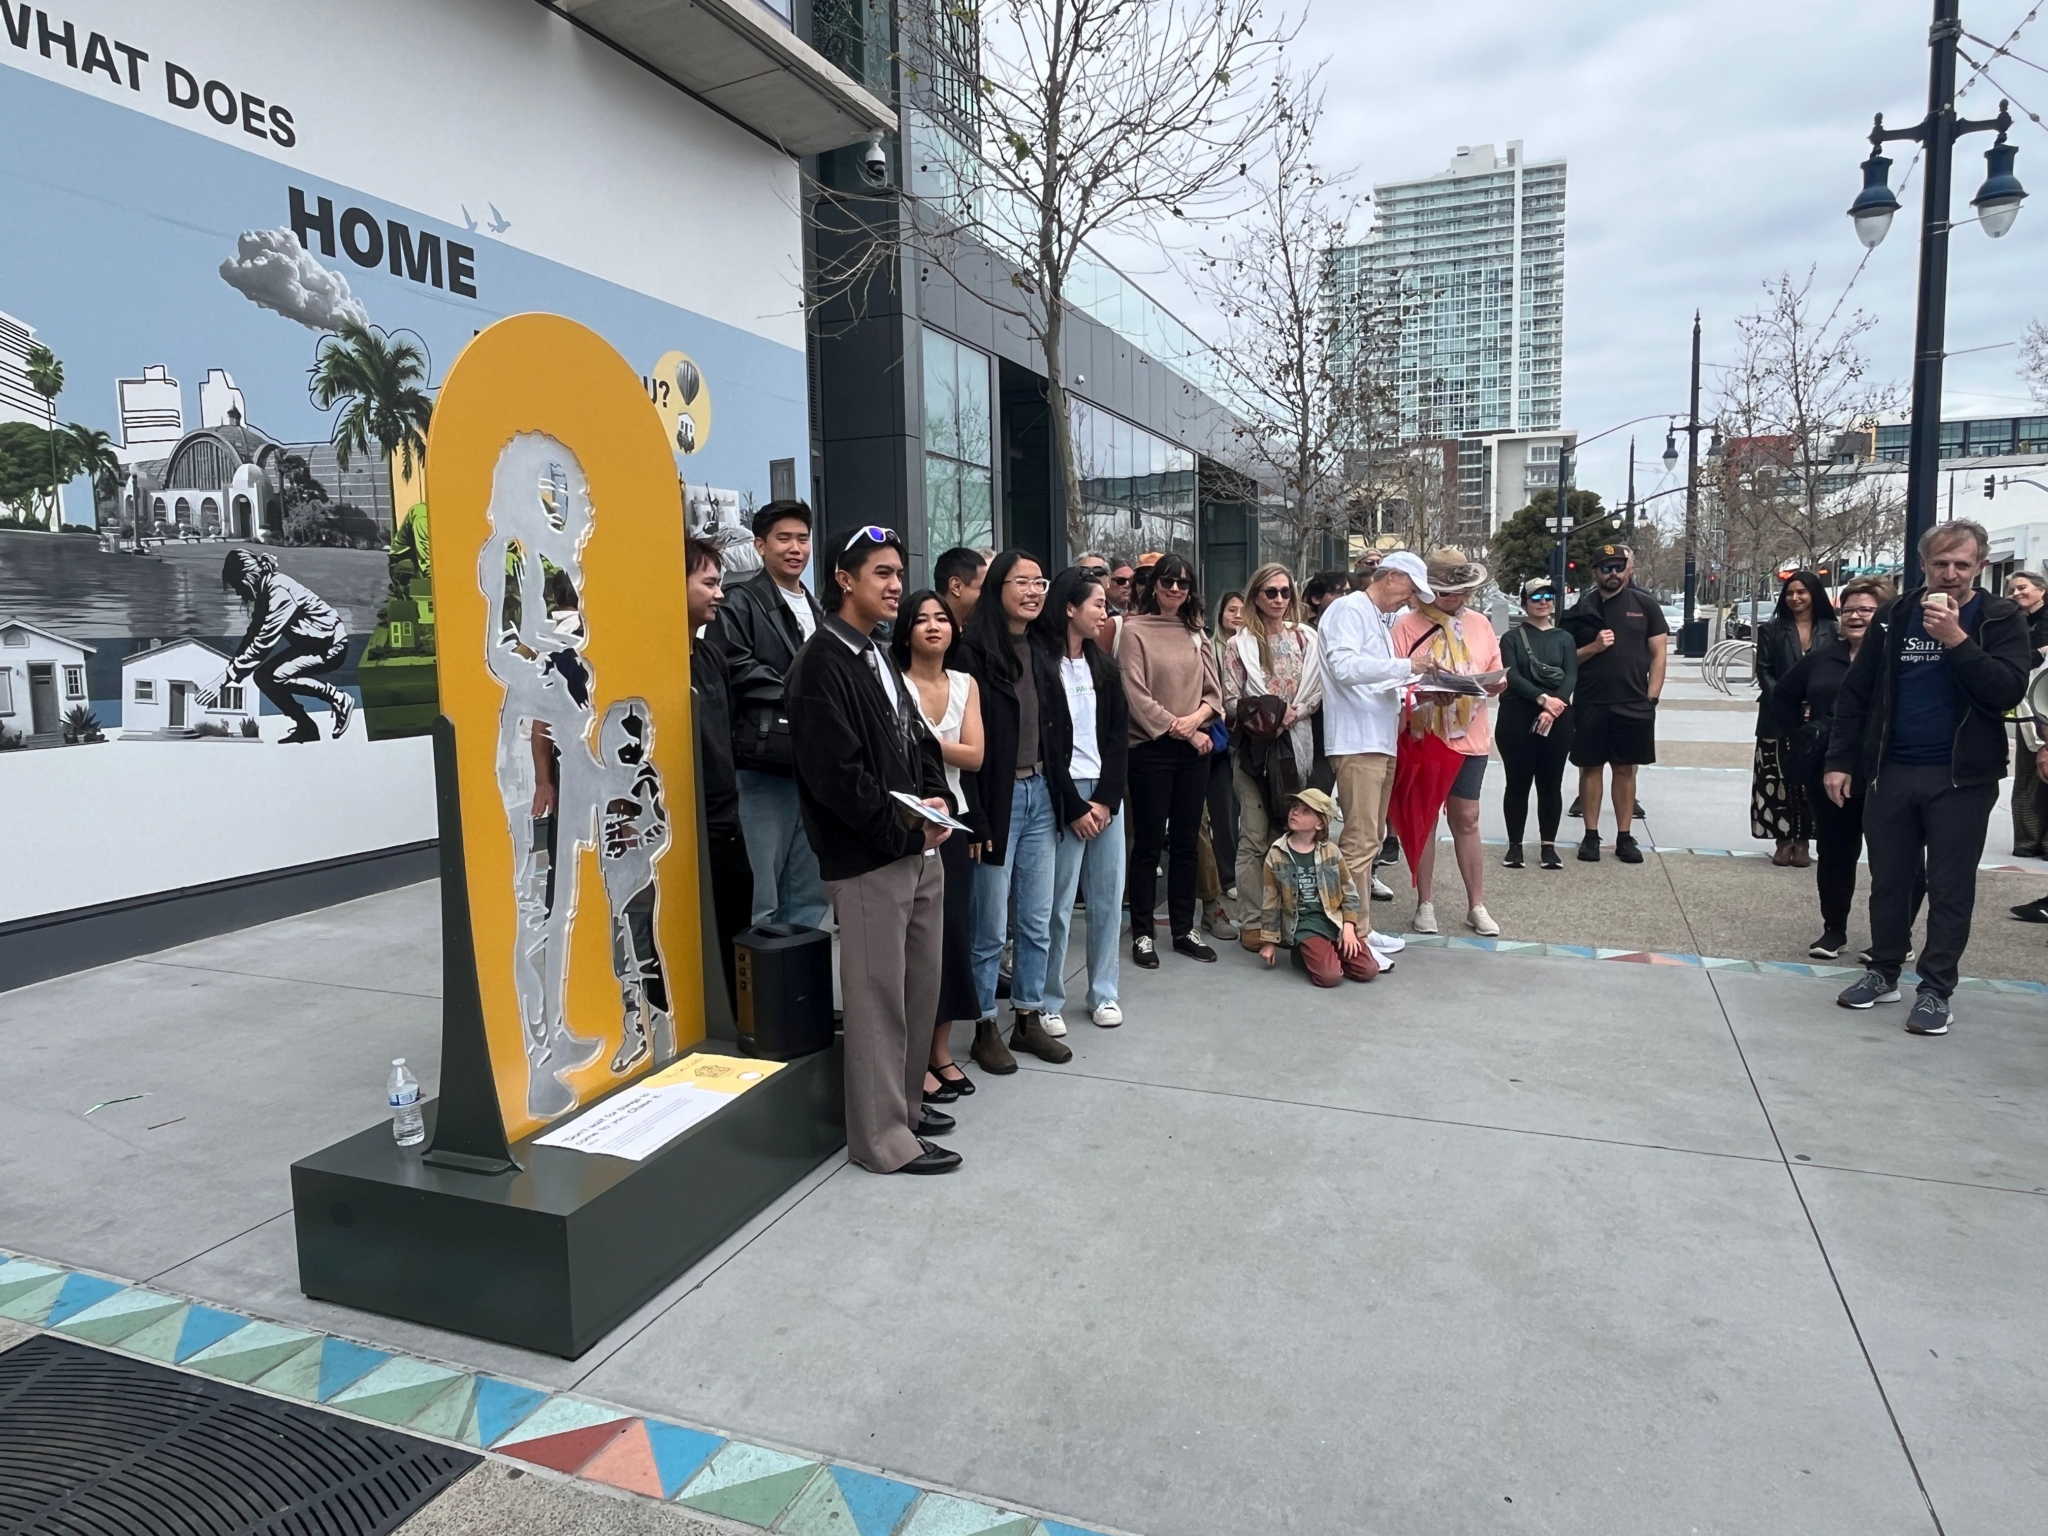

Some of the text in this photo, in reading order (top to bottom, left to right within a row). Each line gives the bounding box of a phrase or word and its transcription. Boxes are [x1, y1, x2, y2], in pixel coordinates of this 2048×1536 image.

[0, 0, 296, 148] WHAT DOES
[288, 185, 477, 299] HOME
[642, 375, 670, 408] U?
[1901, 654, 1924, 663] esign
[1905, 637, 1935, 650] San
